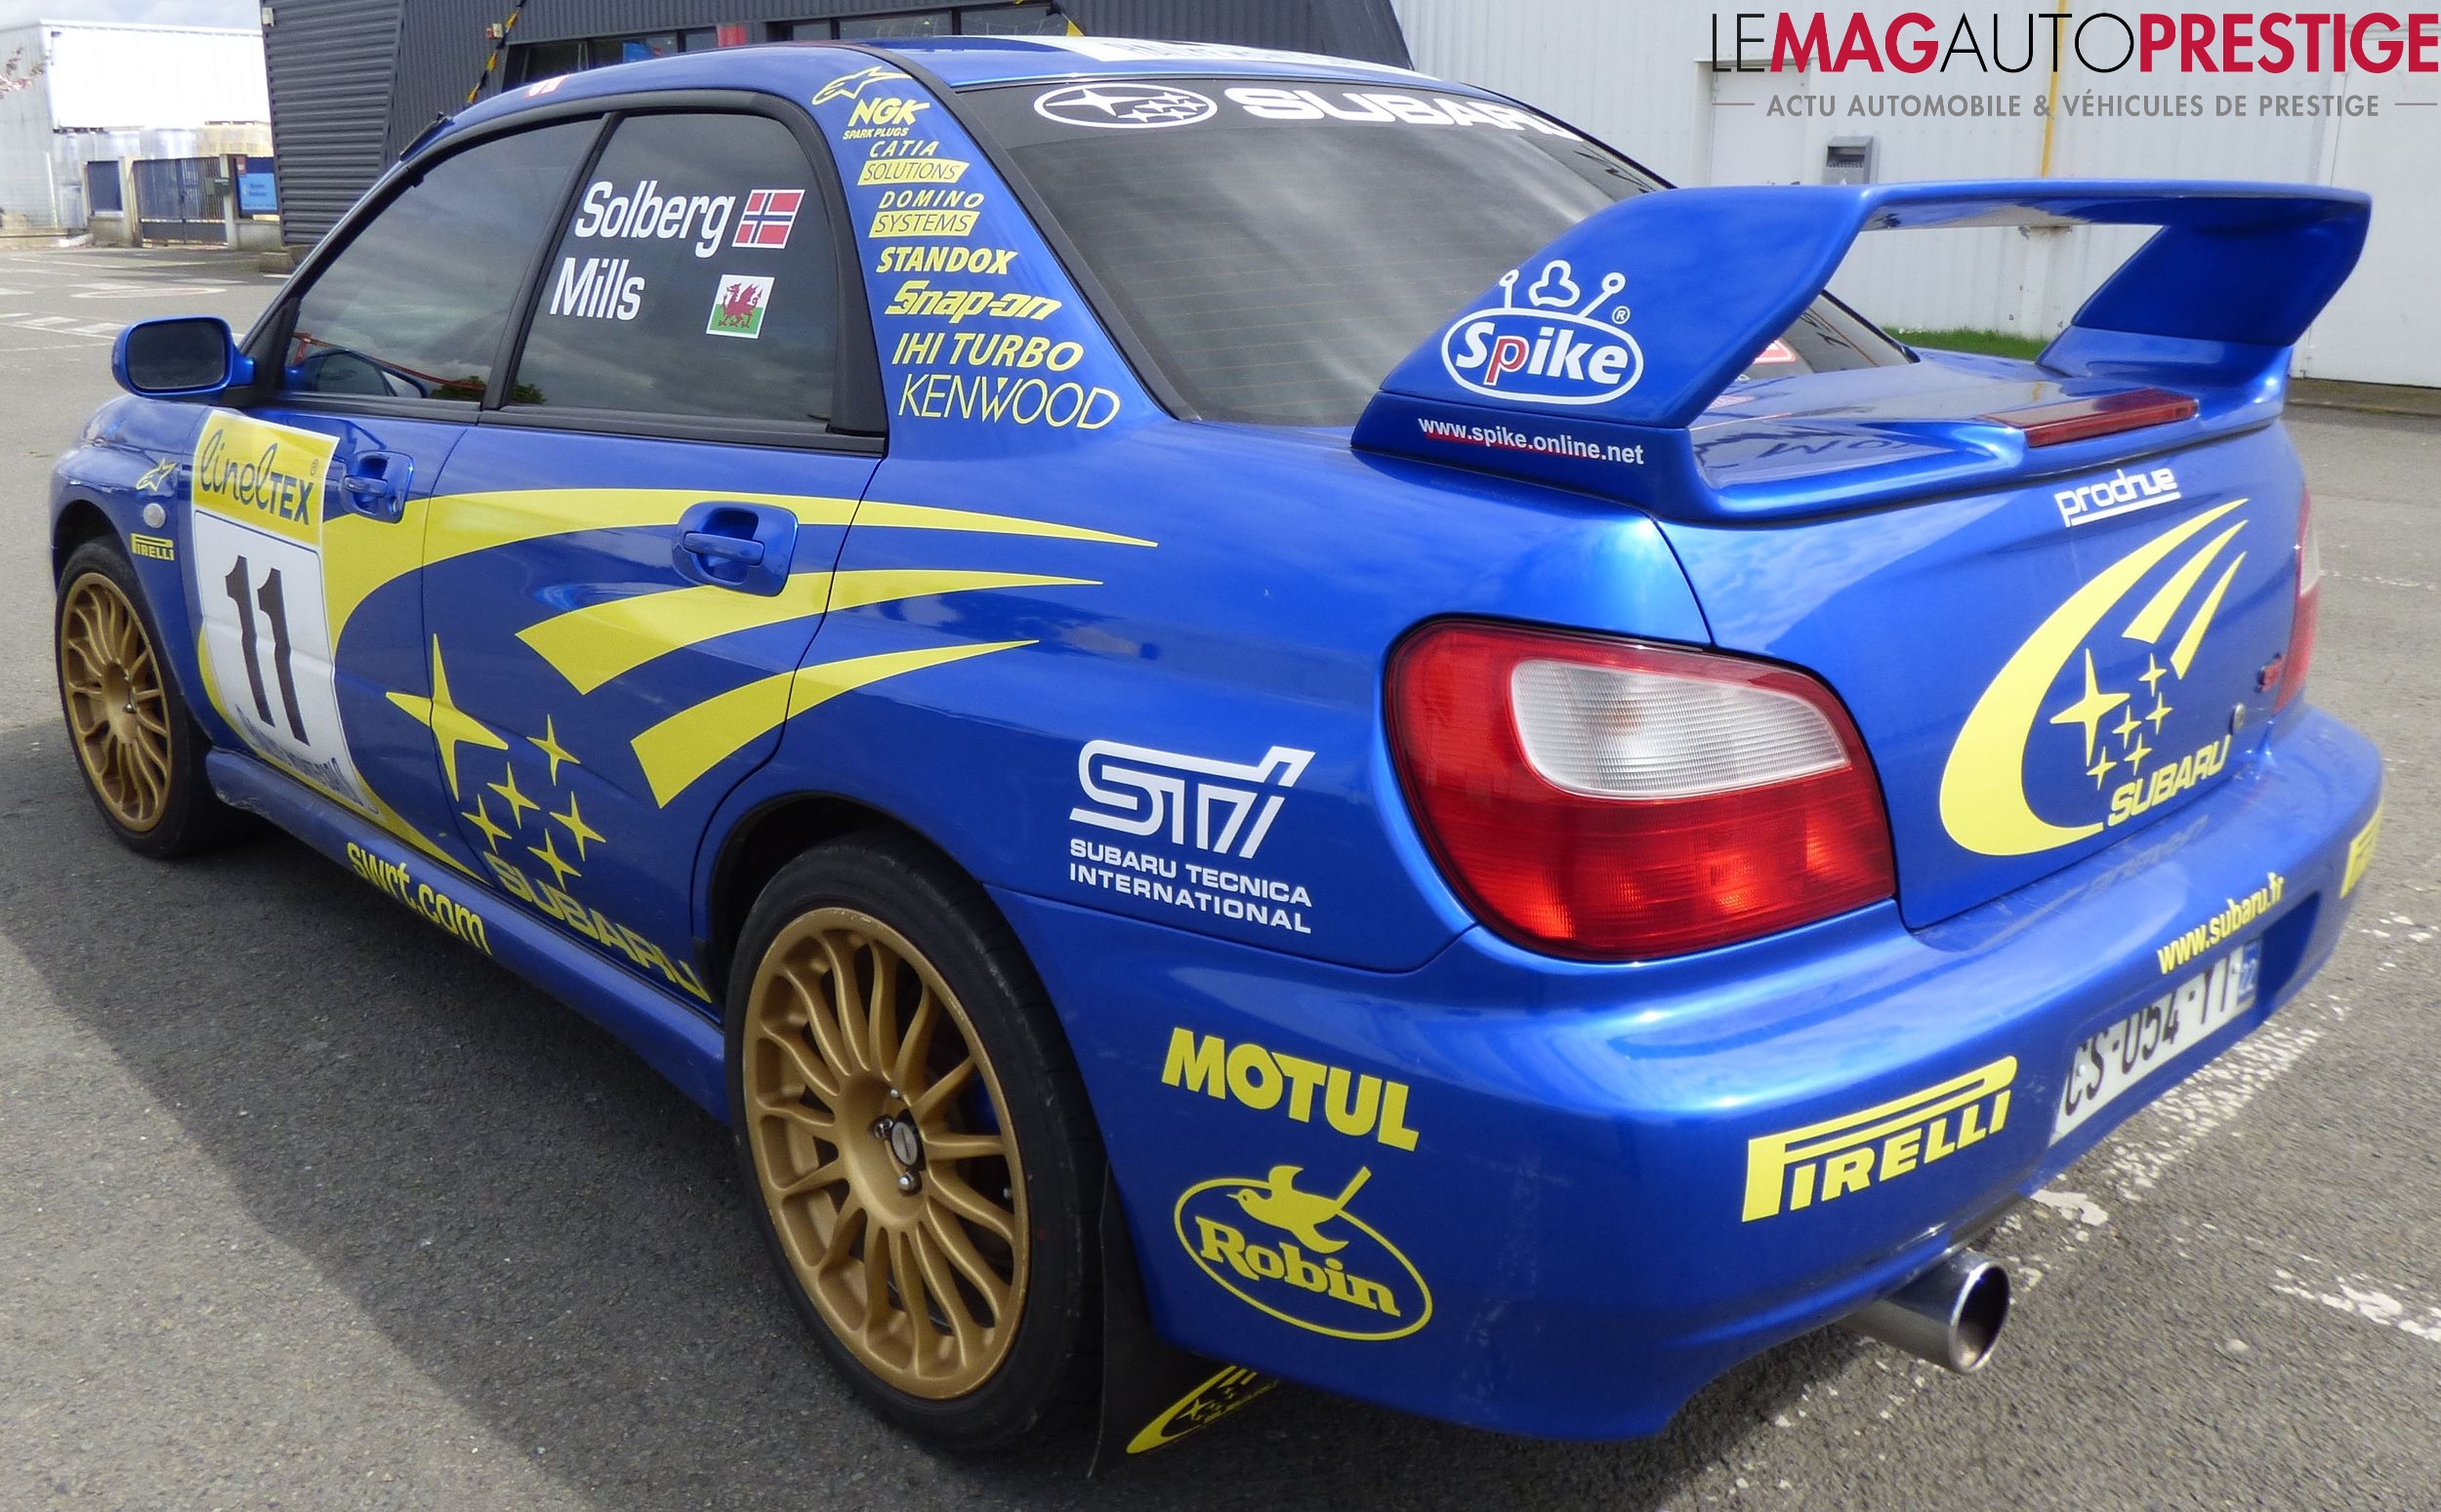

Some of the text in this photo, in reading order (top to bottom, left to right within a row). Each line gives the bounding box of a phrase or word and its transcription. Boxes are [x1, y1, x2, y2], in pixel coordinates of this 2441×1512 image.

[843, 127, 909, 141] SPARK PLUGS
[848, 98, 931, 127] NGK
[863, 162, 960, 182] SOLUTIONS
[869, 140, 939, 158] CATIA
[574, 180, 736, 259] Solberg
[875, 214, 972, 232] SYSTEMS
[878, 189, 985, 209] DOMINO
[549, 257, 645, 320] Mills
[875, 246, 1018, 275] STANDOX
[884, 279, 1062, 323] Snap-on
[891, 333, 1084, 372] IHI TURBO
[1455, 321, 1629, 387] Spike
[898, 373, 1121, 429] KENWOOD
[1418, 418, 1644, 466] www.spike.online.net
[131, 532, 175, 561] PIRELLI
[225, 554, 311, 747] 11
[2107, 735, 2232, 827] SUBARU
[347, 841, 492, 957] swrt.com
[1069, 862, 1311, 934] INTERNATIONAL
[1070, 838, 1312, 908] SUBARU TECNICA
[483, 850, 713, 1003] SUBARU
[2157, 872, 2284, 974] www.subaru.fr
[1161, 1026, 1420, 1152] MOTUL
[1742, 1055, 2018, 1223] PIRELLI
[1195, 1215, 1401, 1318] Robin
